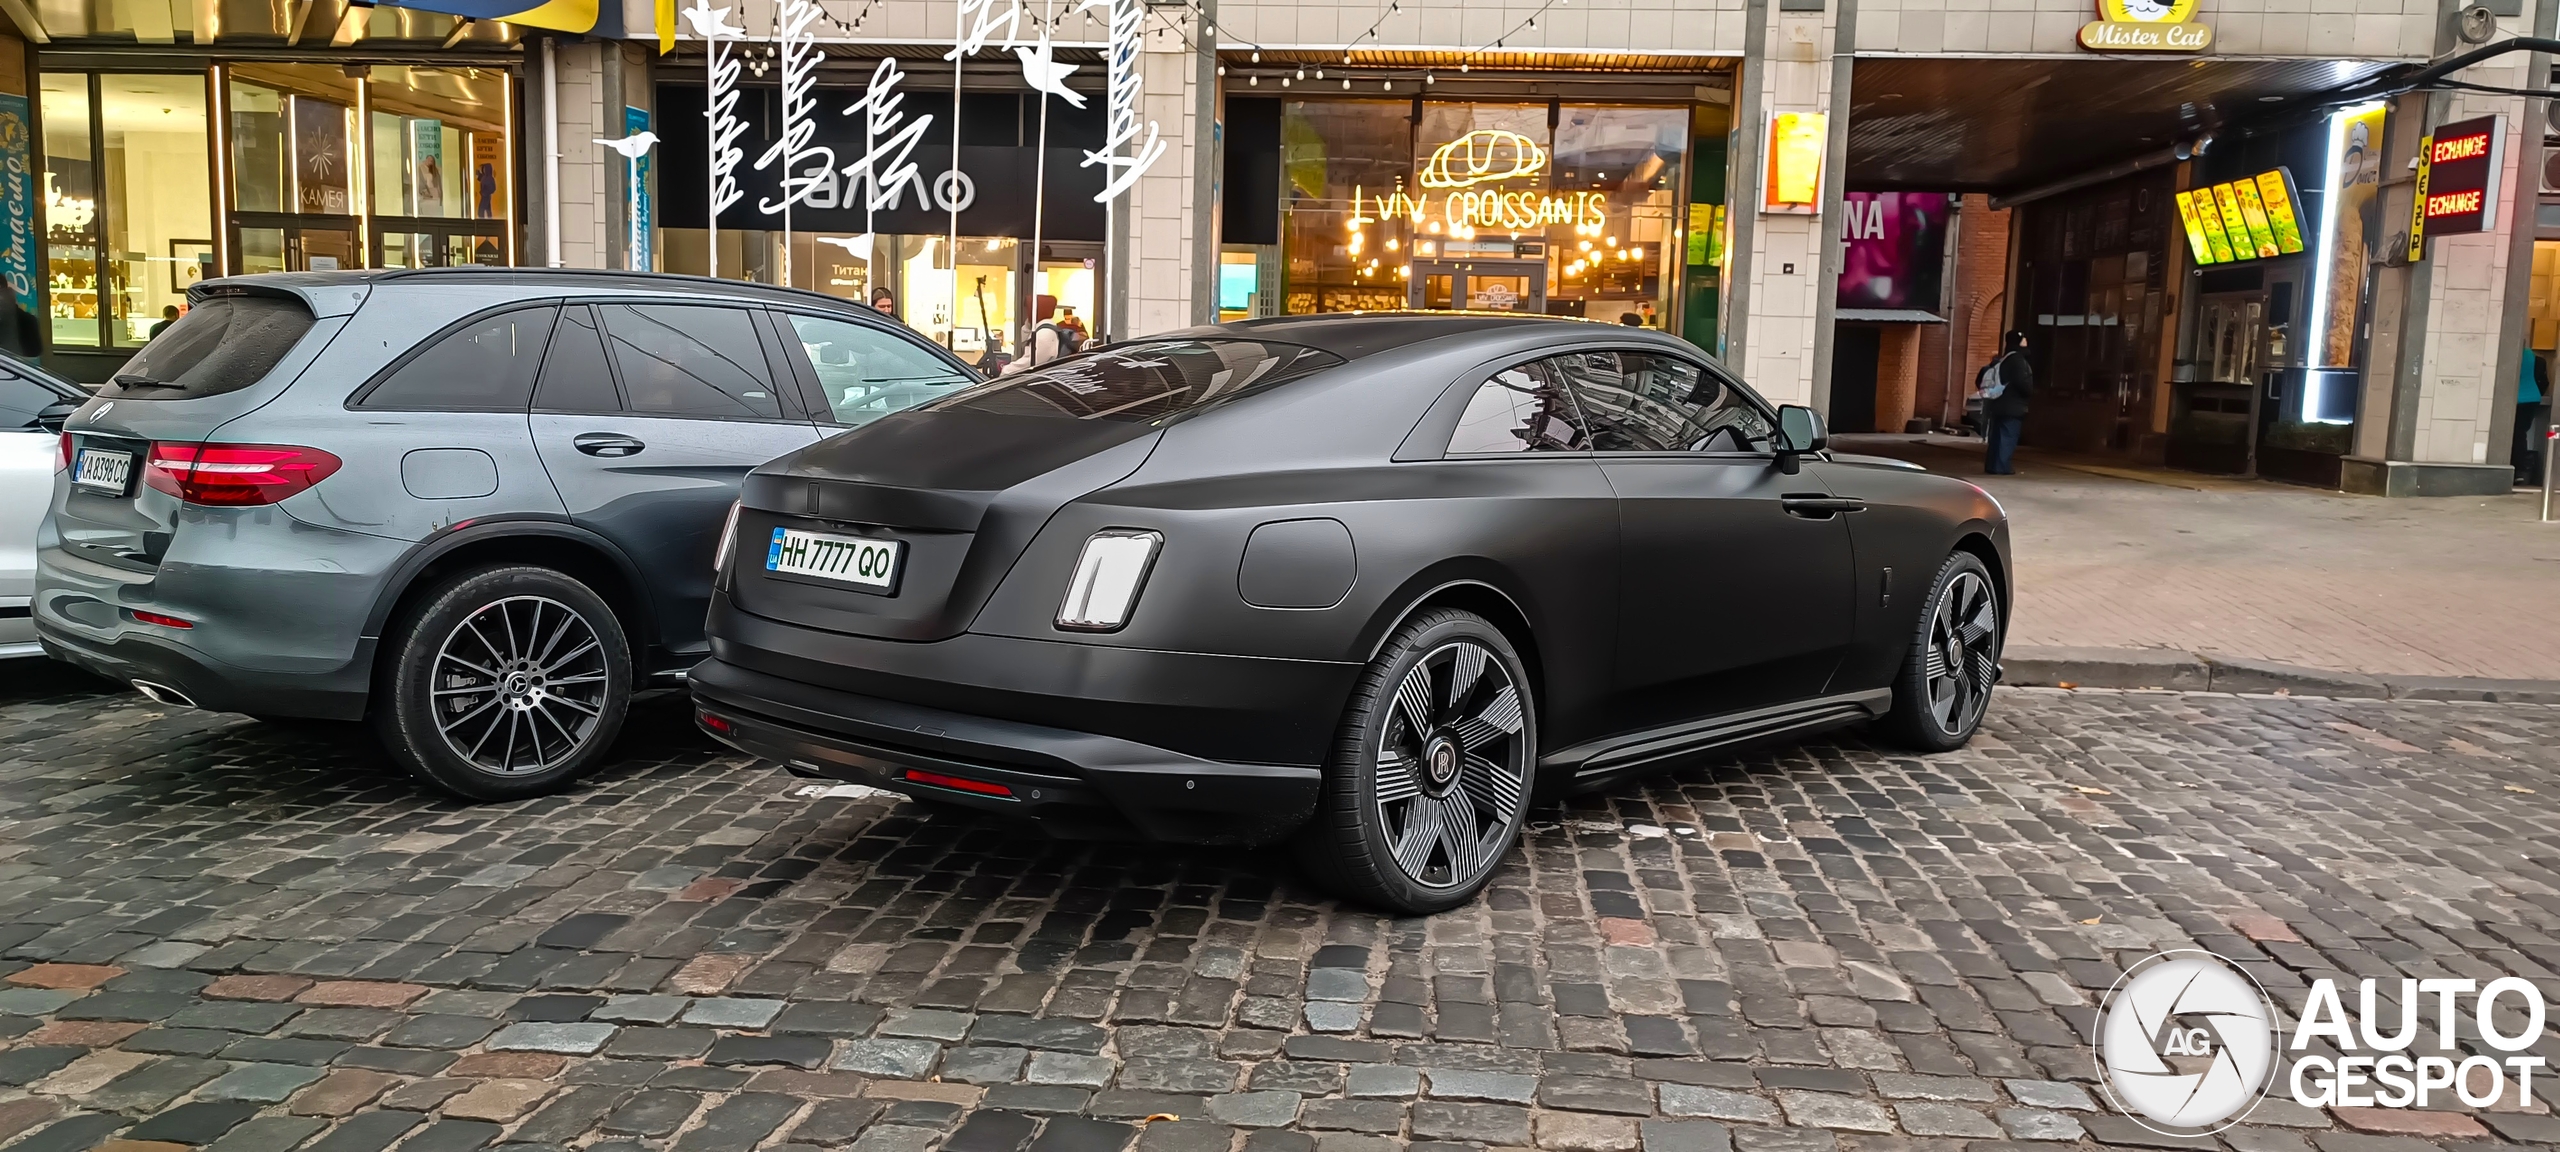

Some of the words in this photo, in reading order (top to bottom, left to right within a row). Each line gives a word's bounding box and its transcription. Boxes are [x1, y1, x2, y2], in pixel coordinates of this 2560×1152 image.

[2087, 24, 2160, 45] Mister
[2166, 25, 2204, 46] Cat
[2434, 135, 2487, 162] ECHANGE
[300, 186, 344, 209] КАМЕЯ
[2428, 191, 2481, 216] ECHANGE
[6, 156, 30, 296] Вітаємо
[832, 264, 868, 276] Титан
[769, 553, 778, 564] UA
[780, 535, 809, 568] HH
[809, 539, 857, 574] 7777
[858, 545, 890, 579] QO
